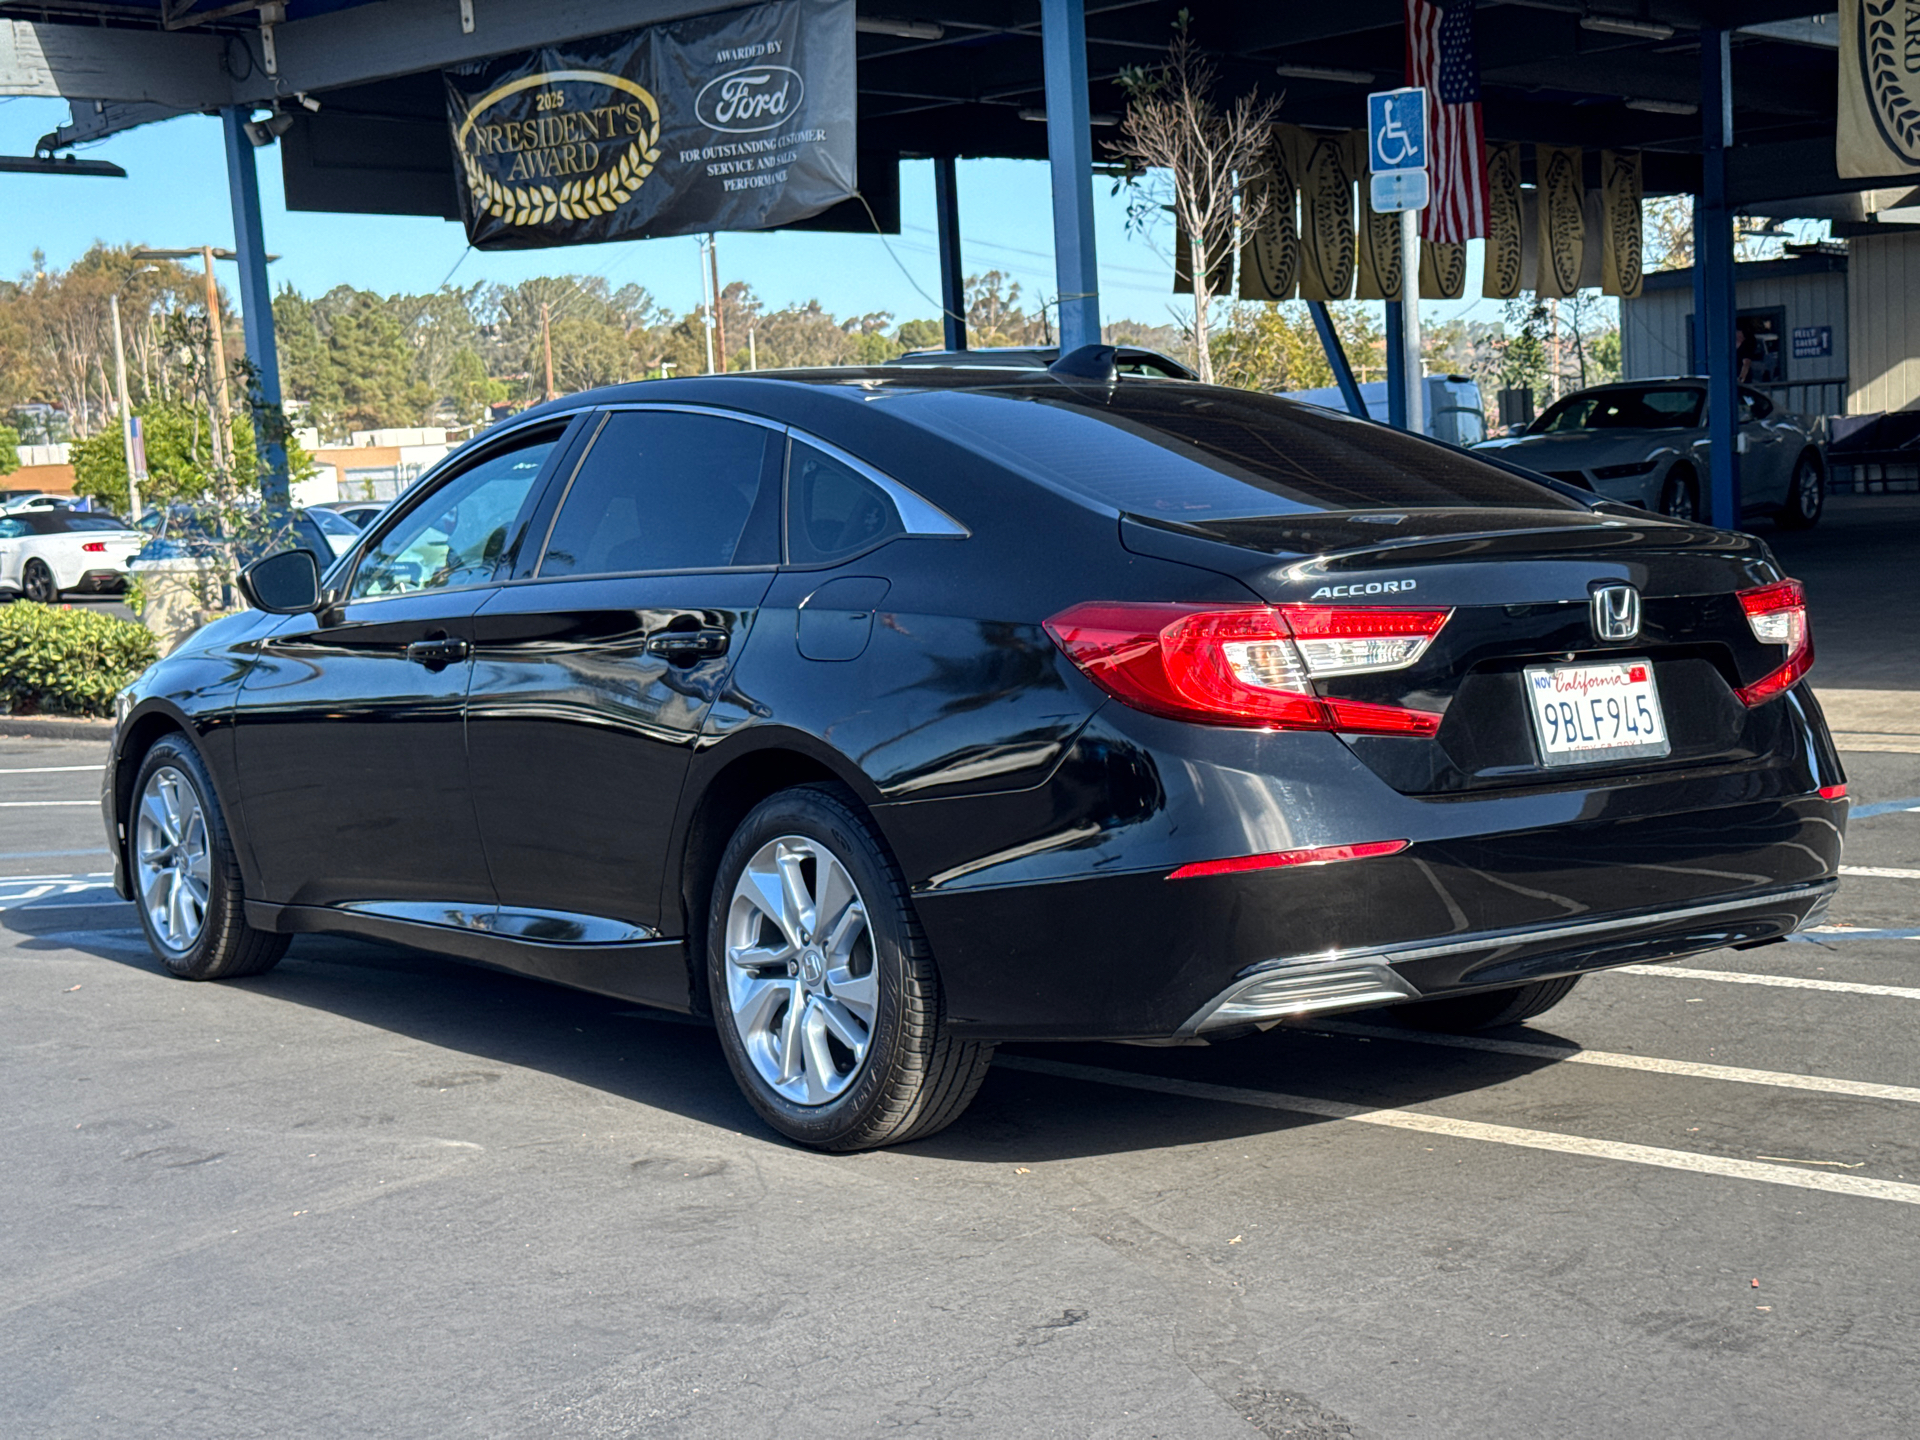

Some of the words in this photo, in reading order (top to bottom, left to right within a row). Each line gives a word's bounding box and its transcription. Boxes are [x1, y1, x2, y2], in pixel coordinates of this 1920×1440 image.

[715, 43, 765, 64] AWARDED
[766, 40, 783, 55] BY
[536, 90, 565, 112] 2025
[715, 74, 789, 123] Ford
[475, 102, 643, 157] PRESIDENT'S
[679, 149, 701, 163] FOR
[702, 138, 777, 160] OUTSTANDING
[777, 128, 827, 149] CUSTOMER
[507, 141, 600, 181] AWARD
[706, 159, 755, 177] SERVICE
[756, 155, 776, 171] AND
[776, 151, 798, 166] SALES
[723, 169, 789, 192] PERFORMANCE
[1311, 579, 1417, 599] ACCORD
[1534, 676, 1552, 689] NOV
[1554, 670, 1630, 697] California
[1544, 694, 1654, 746] 9BLF945
